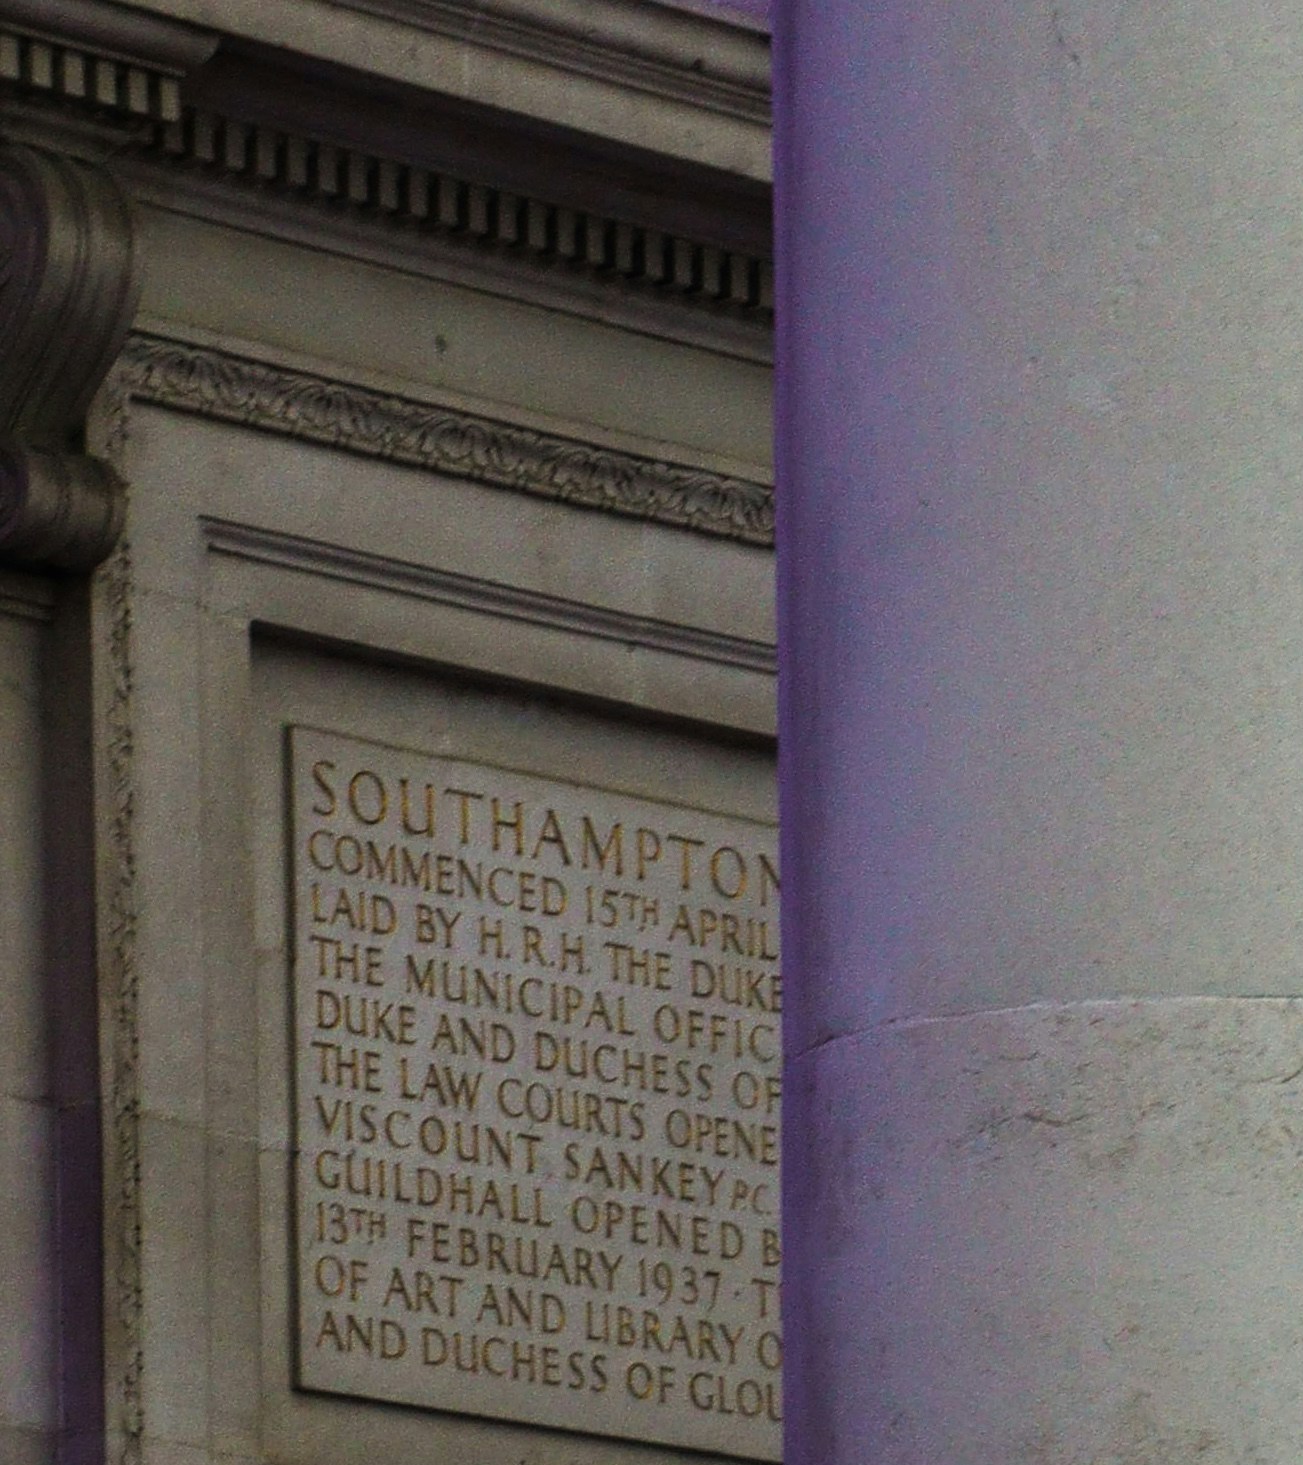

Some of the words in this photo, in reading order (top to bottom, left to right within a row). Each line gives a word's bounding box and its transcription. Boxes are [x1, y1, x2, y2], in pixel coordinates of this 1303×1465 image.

[312, 760, 781, 907] SOUTHAMPTON
[309, 829, 567, 916] COMMENCED
[586, 886, 660, 930] 15TH
[667, 905, 778, 961] APRIL
[312, 883, 396, 935] LAID
[416, 904, 462, 948] BY
[603, 941, 672, 990] THE
[691, 959, 782, 1013] DUKE
[309, 934, 384, 986] THE
[405, 954, 635, 1036] MUNICIPAL
[310, 1041, 381, 1092] THE
[400, 1057, 484, 1111] LAW
[497, 1078, 645, 1141] COURTS
[316, 989, 417, 1044] DUKE
[431, 1014, 515, 1063] AND
[534, 1031, 713, 1101] DUCHESS
[732, 1071, 782, 1113] OF
[315, 1094, 542, 1174] VISCOUNT
[564, 1142, 725, 1206] SANKEY
[316, 1149, 552, 1227] GUILDHALL
[572, 1196, 743, 1259] OPENED
[316, 1202, 386, 1244] 13TH
[408, 1219, 624, 1293] FEBRUARY
[315, 1256, 368, 1301] OF
[383, 1268, 464, 1317] ART
[477, 1284, 565, 1334] AND
[586, 1301, 744, 1365] LIBRARY
[316, 1311, 406, 1359] AND
[422, 1327, 608, 1393] DUCHESS
[627, 1362, 676, 1404] OF
